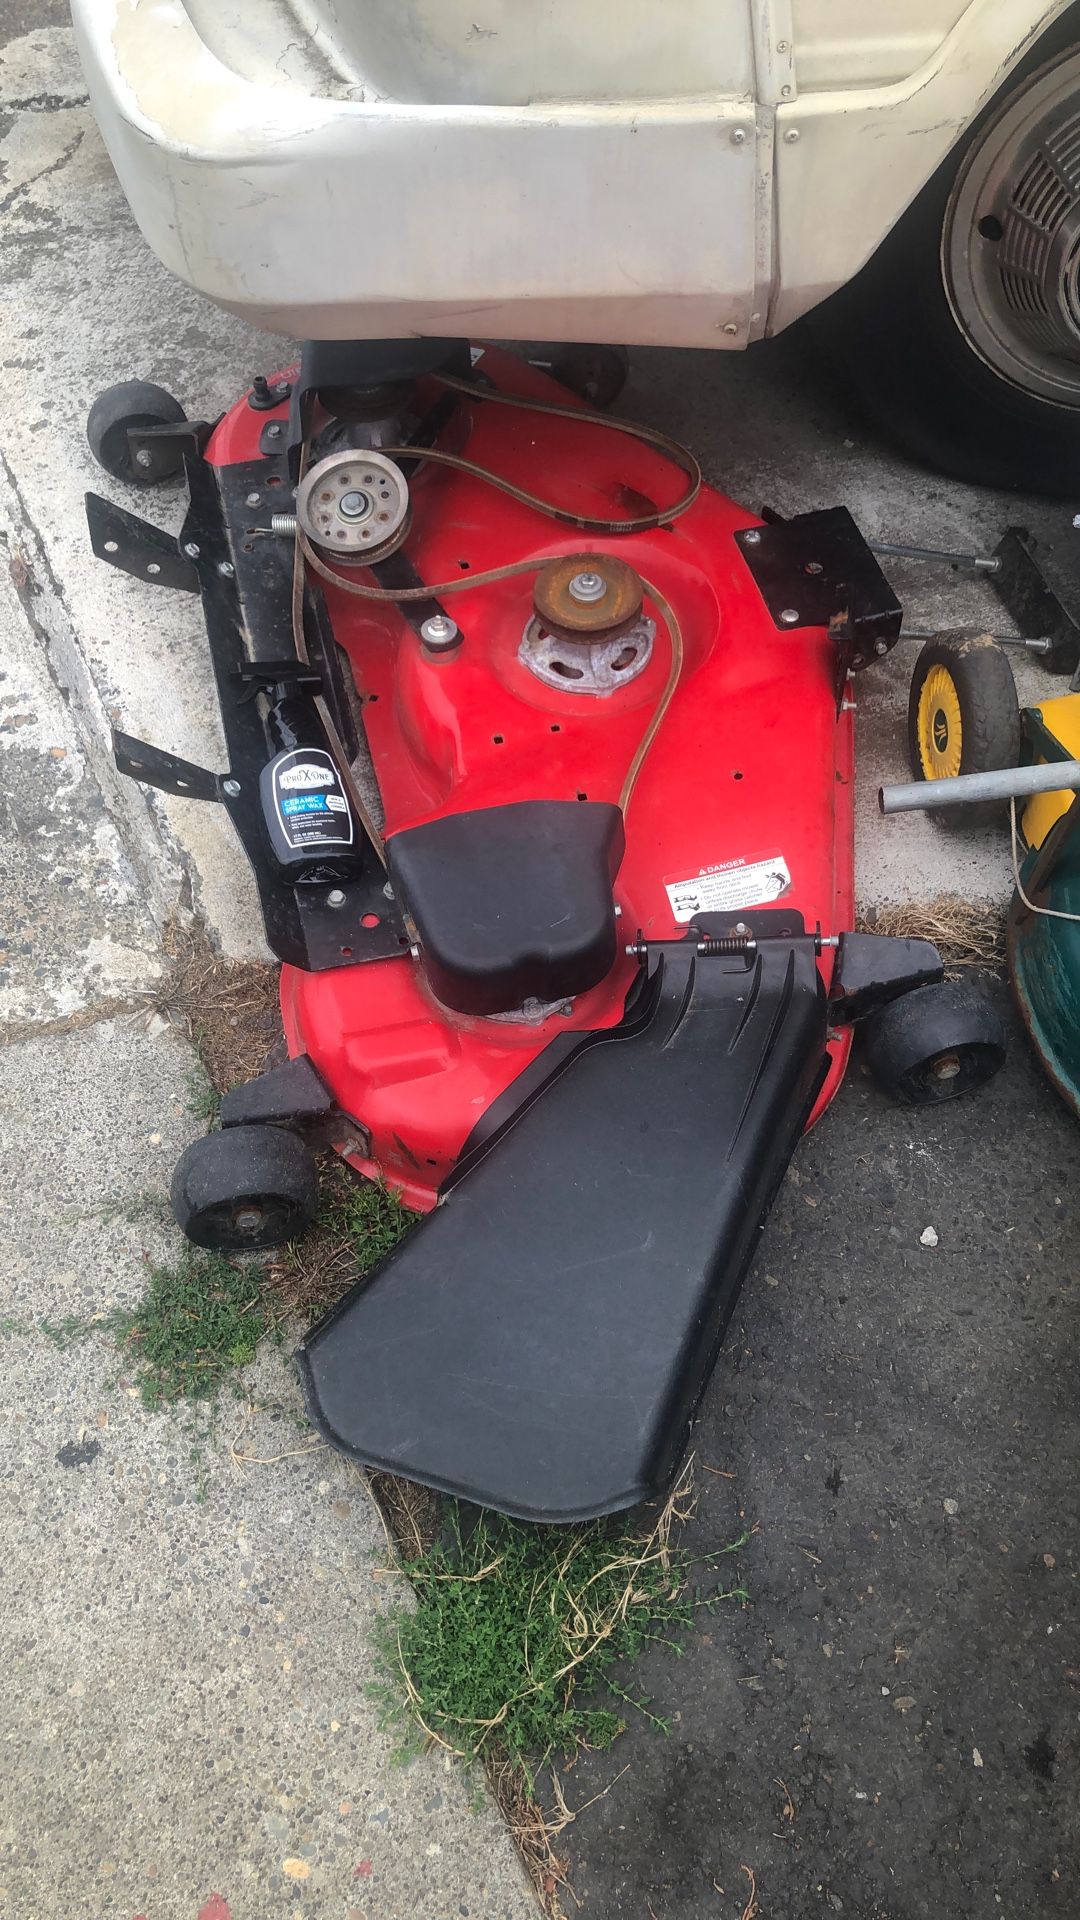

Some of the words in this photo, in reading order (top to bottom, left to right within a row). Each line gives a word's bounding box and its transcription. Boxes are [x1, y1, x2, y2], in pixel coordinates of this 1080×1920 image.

[284, 796, 319, 807] CERAMIC
[286, 805, 306, 813] SPRAY
[707, 859, 745, 873] DANGER
